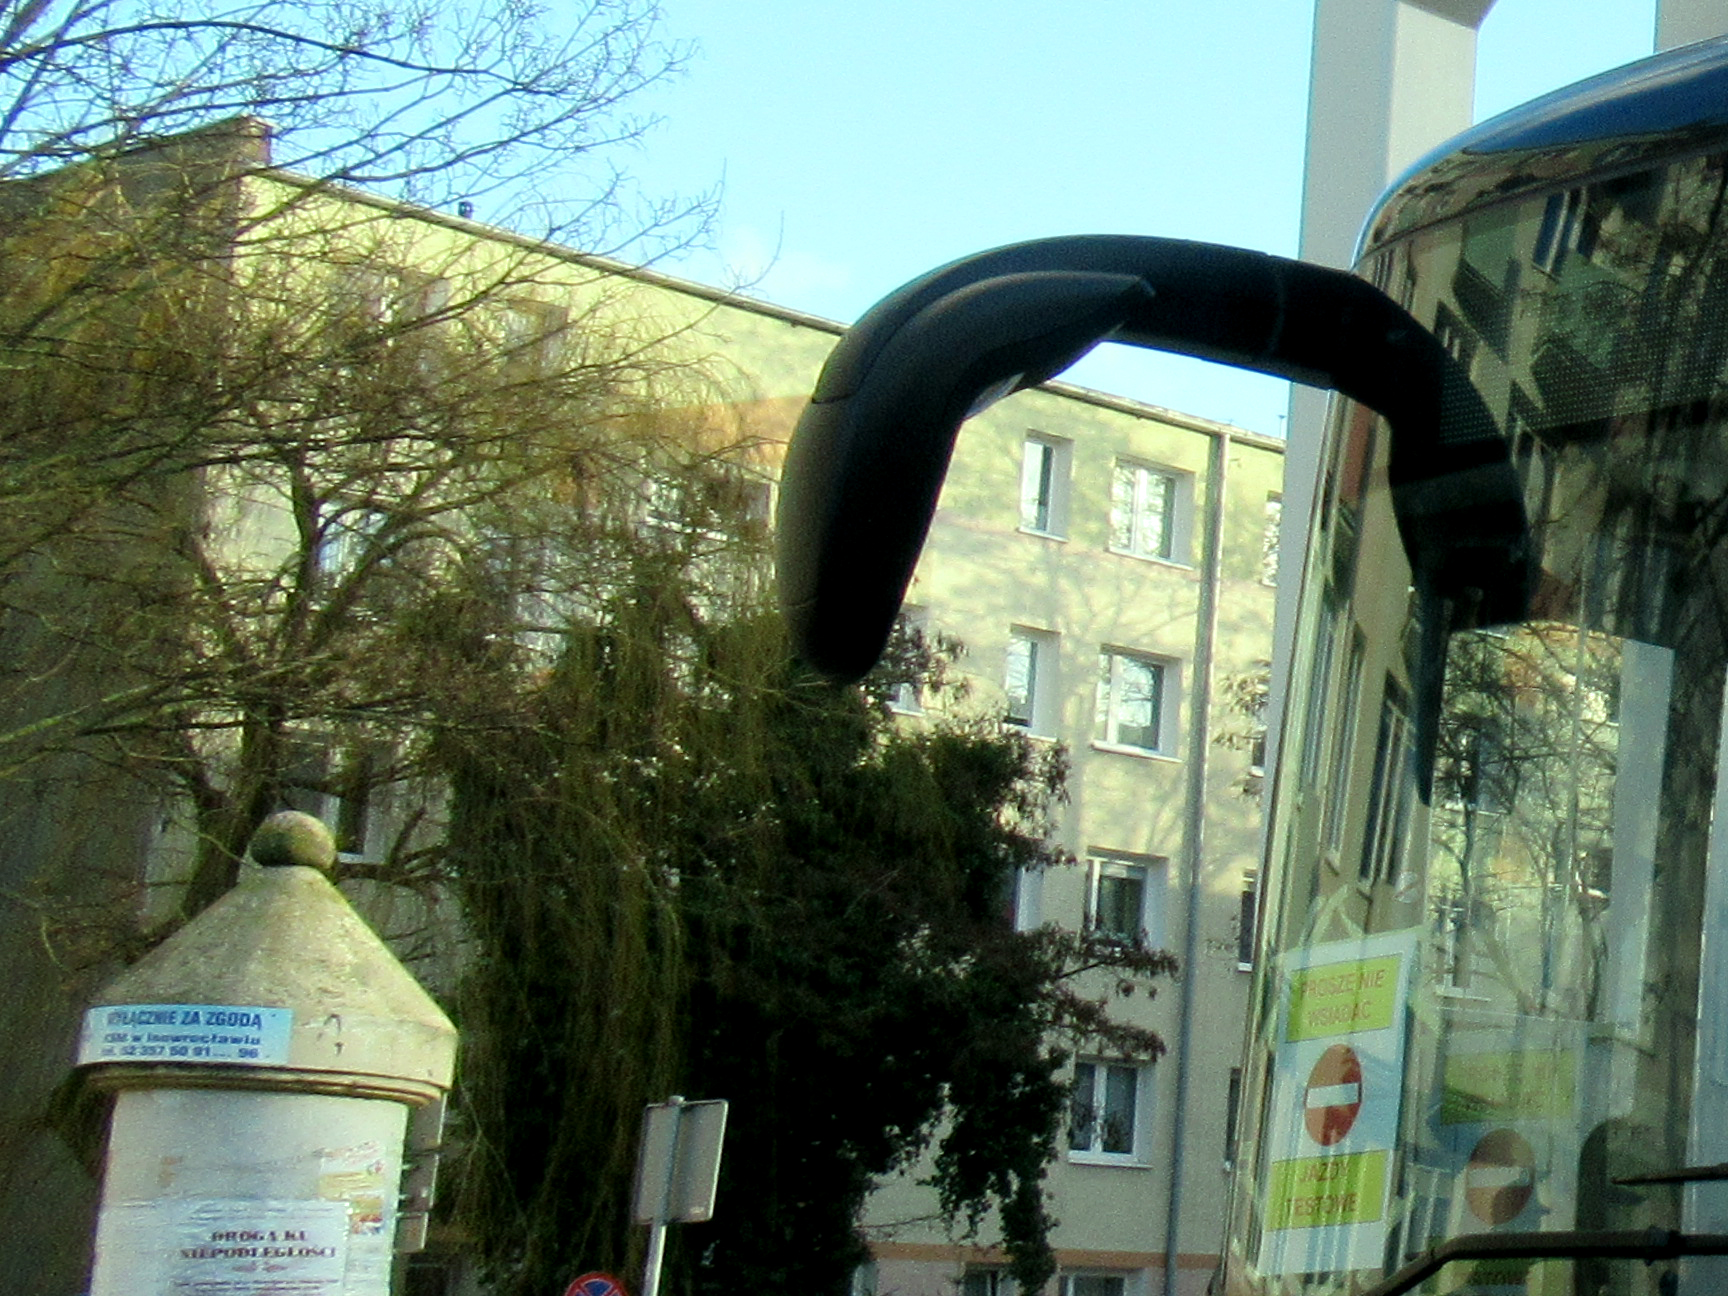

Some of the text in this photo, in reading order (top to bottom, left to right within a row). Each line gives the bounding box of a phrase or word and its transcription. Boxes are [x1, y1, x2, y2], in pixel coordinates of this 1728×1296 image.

[1360, 969, 1386, 990] NIE
[180, 1010, 200, 1025] ZA
[206, 1011, 262, 1030] ZGODĄ
[1286, 1192, 1359, 1217] TESTOWE
